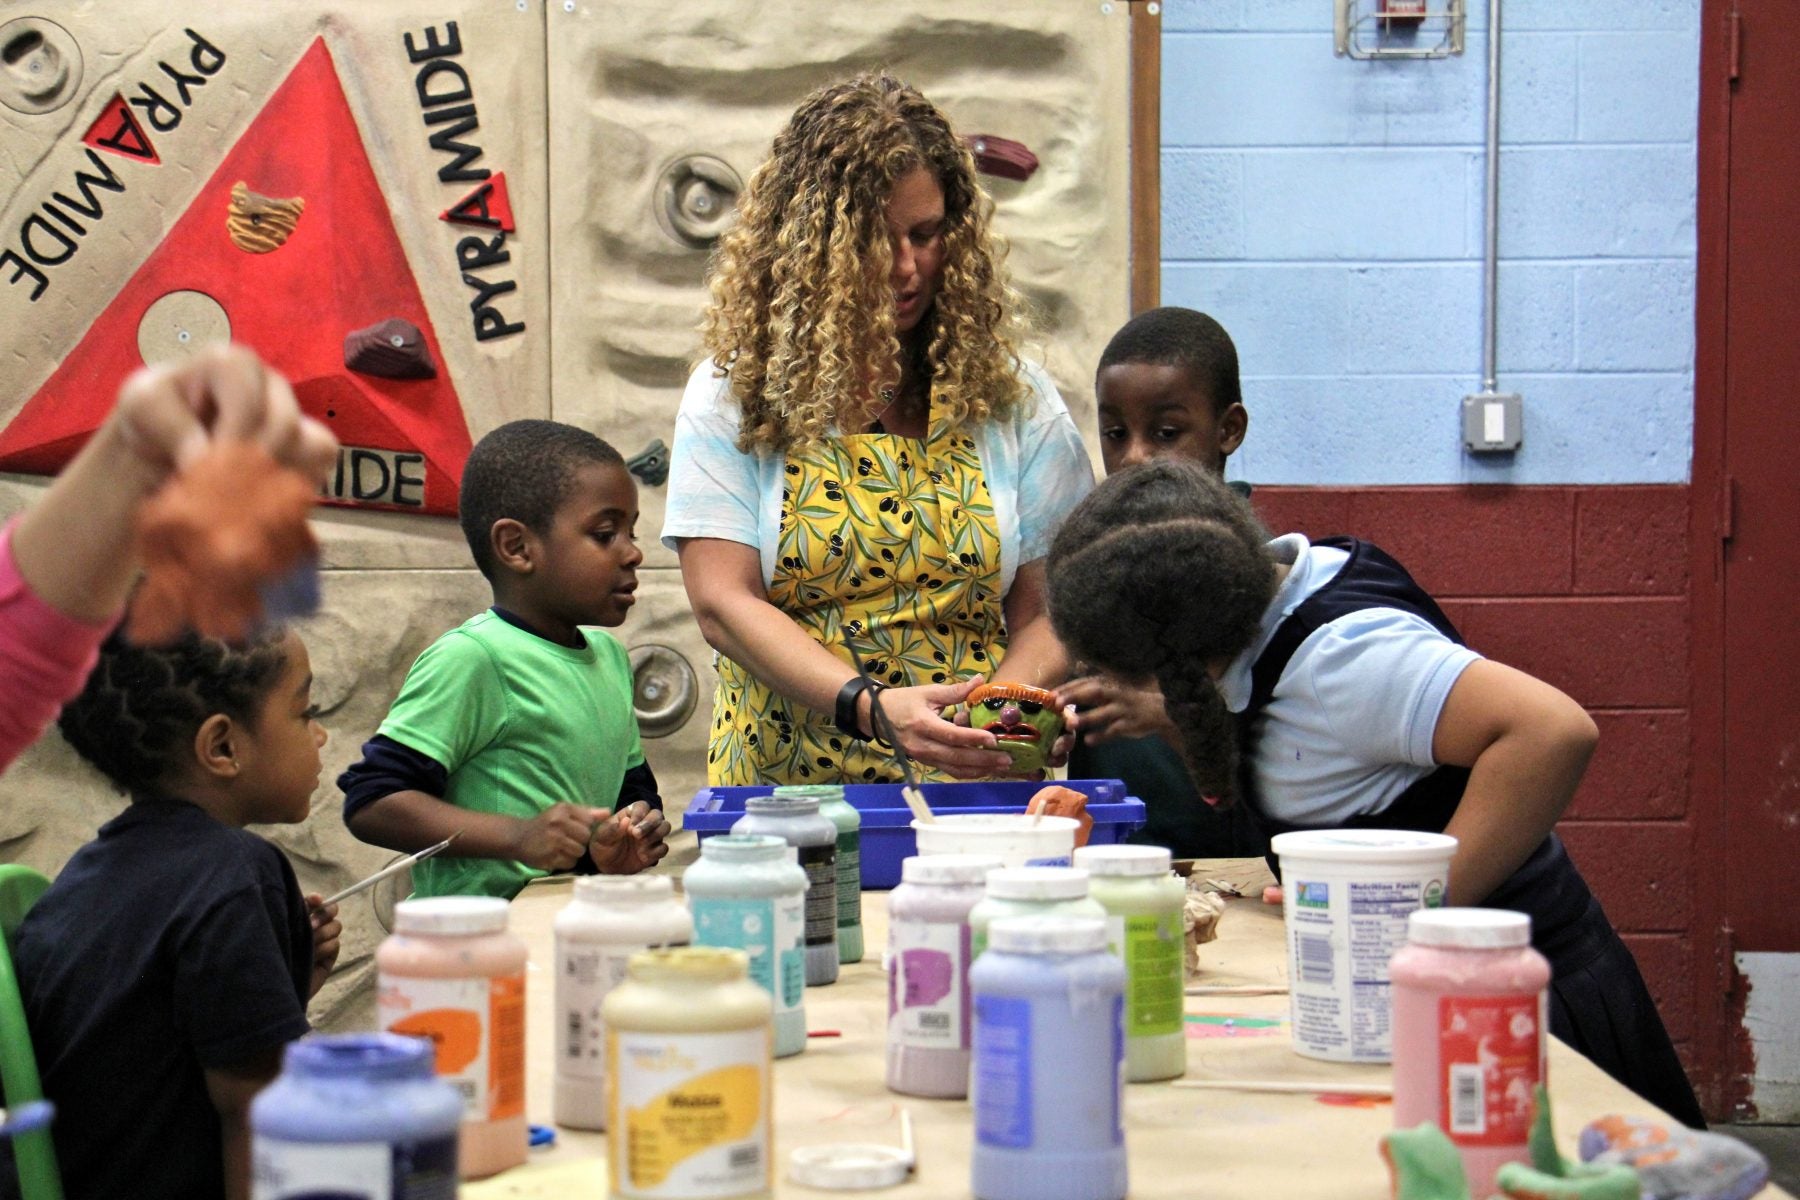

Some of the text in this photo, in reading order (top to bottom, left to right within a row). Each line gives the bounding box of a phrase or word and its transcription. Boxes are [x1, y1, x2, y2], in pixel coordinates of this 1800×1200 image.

[0, 27, 226, 302] PYRAMIDE
[403, 20, 526, 342] PYRAMIDE
[322, 448, 424, 506] IDE
